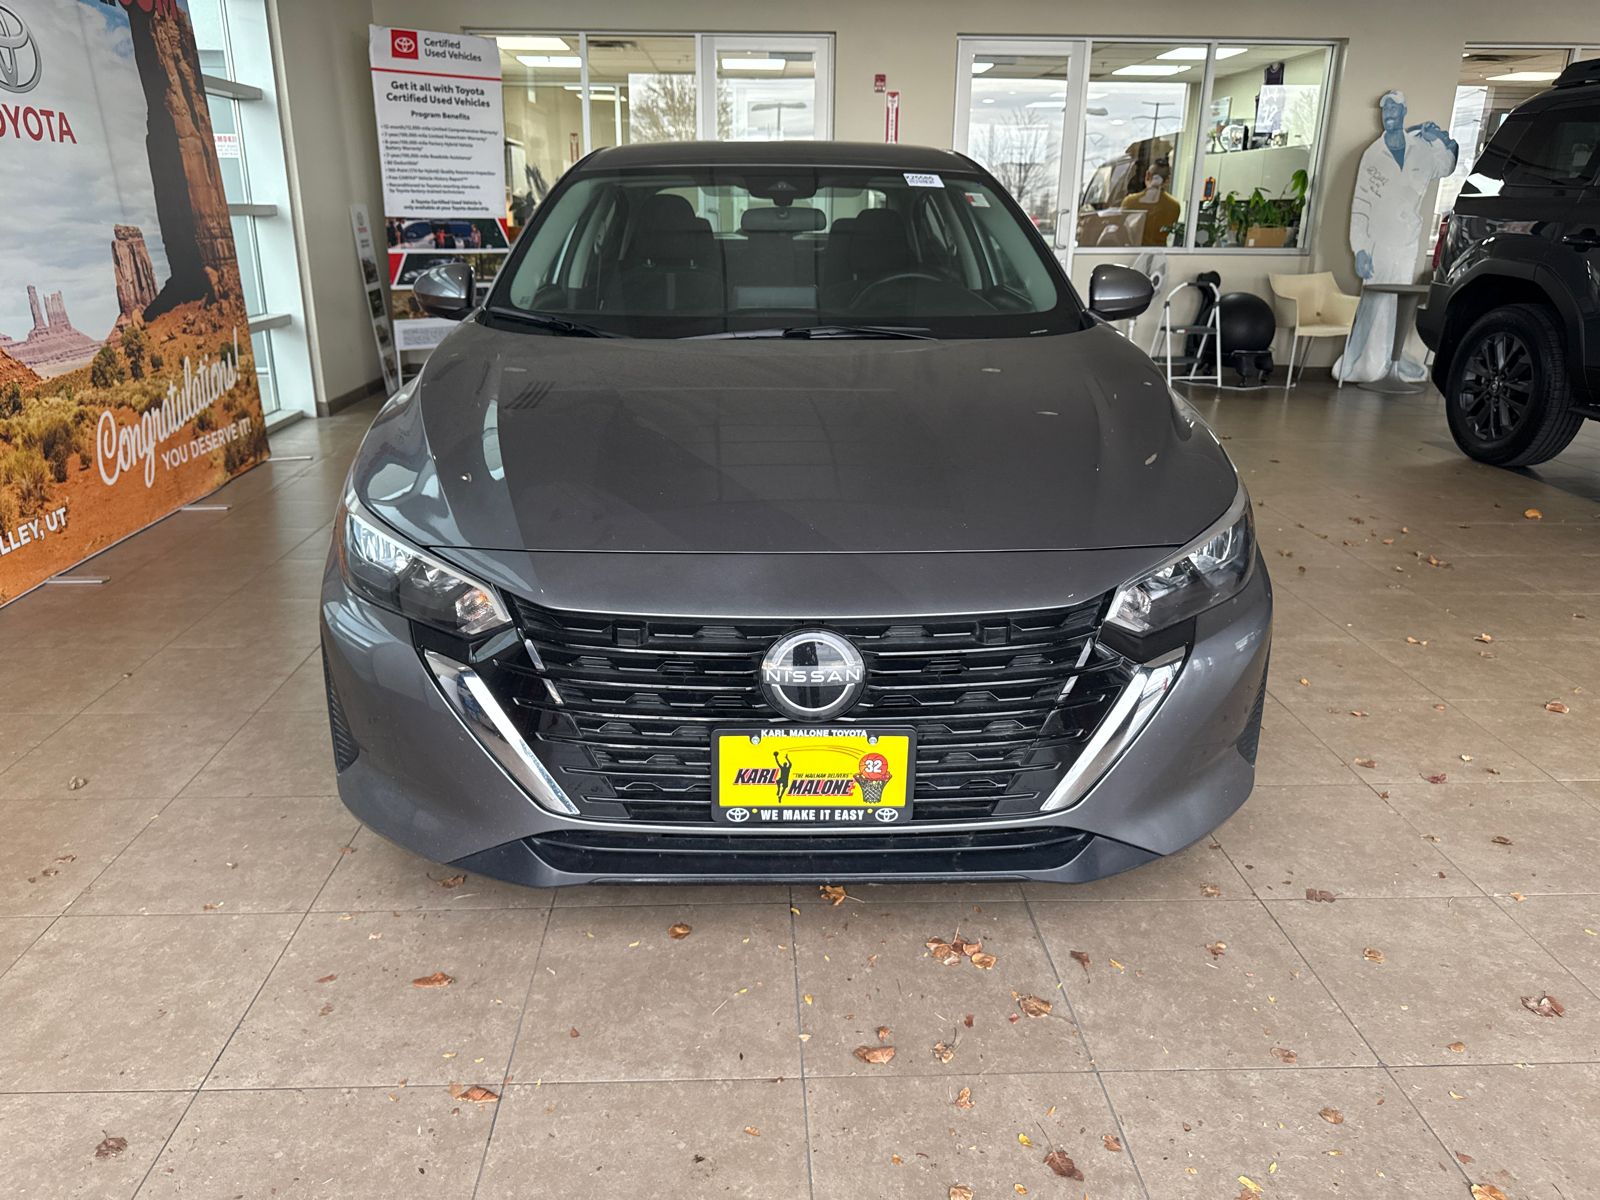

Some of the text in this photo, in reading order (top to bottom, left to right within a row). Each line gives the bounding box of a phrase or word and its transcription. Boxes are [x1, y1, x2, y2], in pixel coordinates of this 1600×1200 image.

[424, 38, 460, 49] Certified
[425, 49, 482, 62] Used Vehicles
[390, 80, 484, 96] Get it all with Toyota
[386, 92, 490, 107] Certified Used Vehicles
[411, 110, 469, 120] Program Benefits
[97, 326, 241, 488] Congratulations!
[161, 417, 252, 471] YOU DESERVE IT!
[45, 507, 66, 531] UT
[766, 669, 860, 683] NISSAN
[761, 729, 867, 737] KARL MALONE TOYOTA
[865, 760, 882, 773] 32
[733, 768, 779, 785] KARL
[787, 779, 855, 796] MALONE
[761, 809, 865, 820] WE MAKE IT EASY
